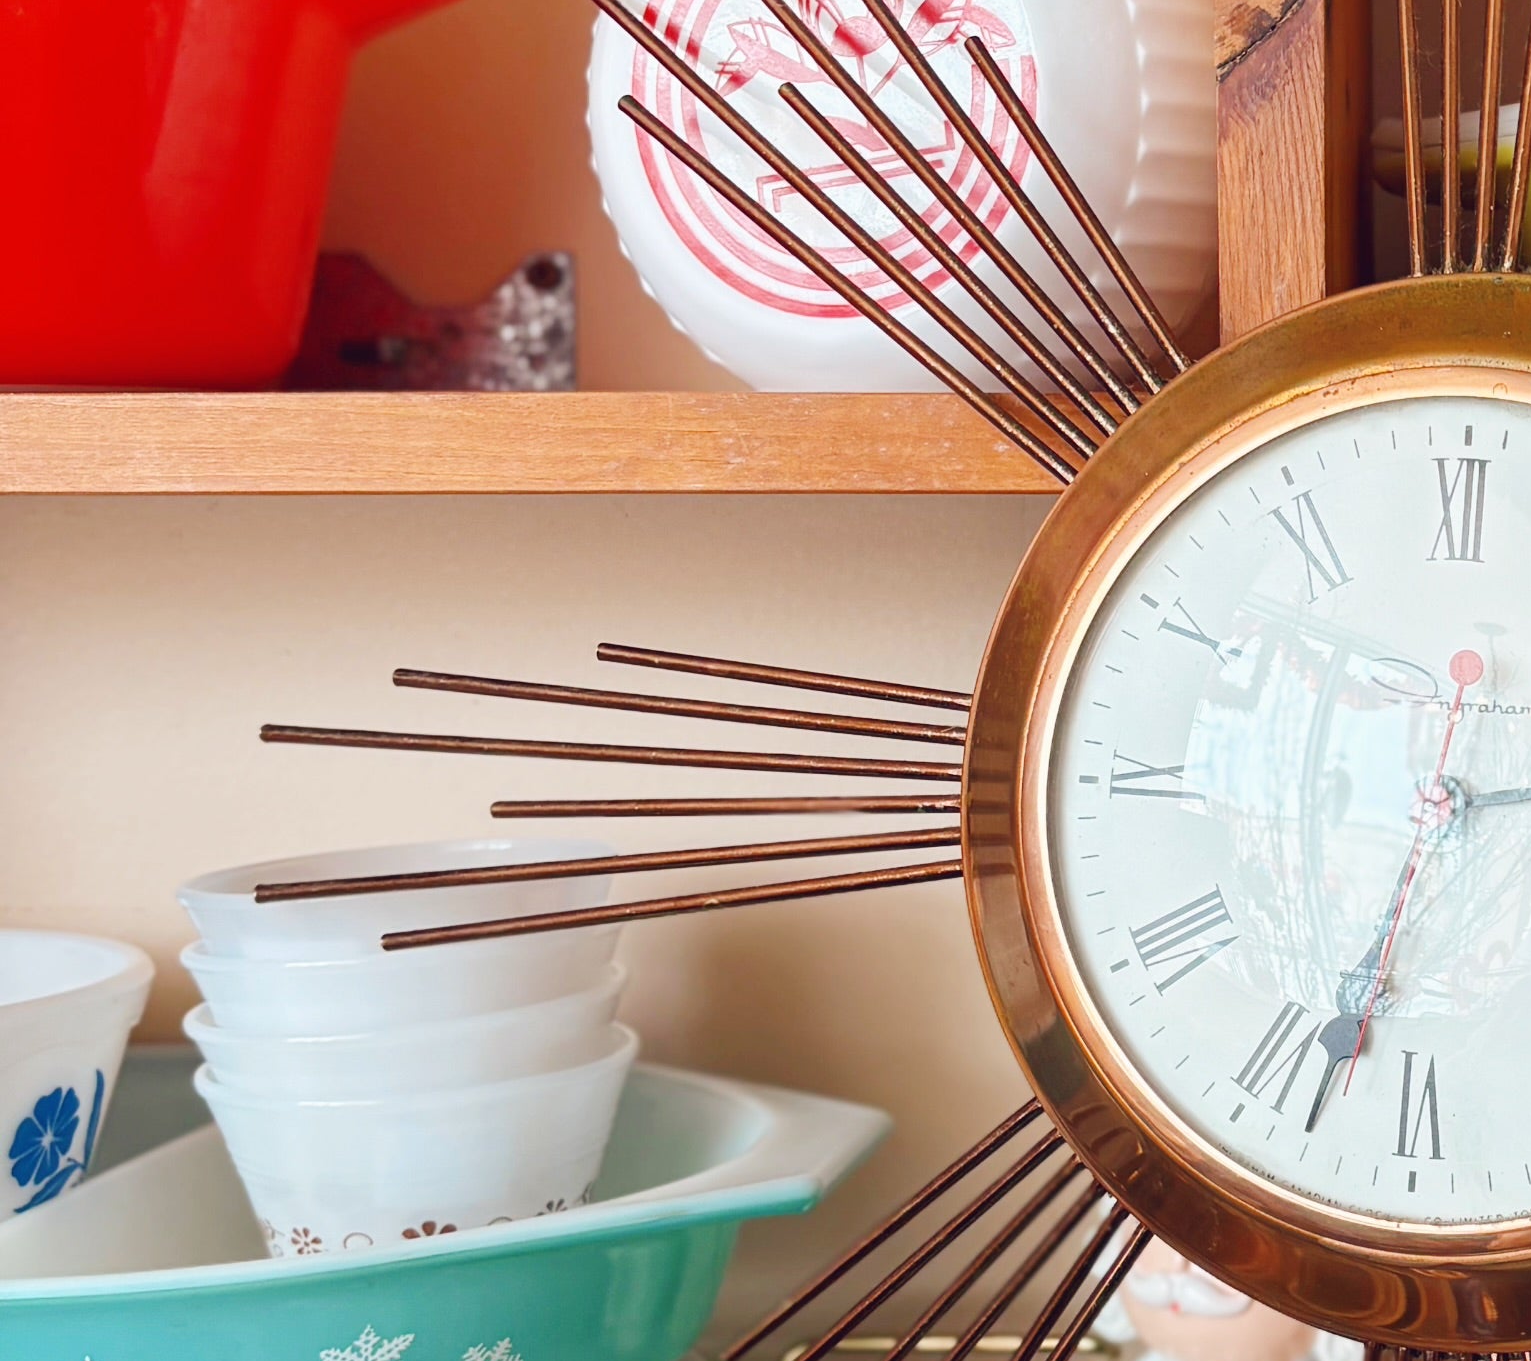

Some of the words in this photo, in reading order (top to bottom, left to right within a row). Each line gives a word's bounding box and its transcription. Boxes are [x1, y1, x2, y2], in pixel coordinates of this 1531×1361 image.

[1266, 489, 1355, 605] XI
[1425, 457, 1492, 564] XII
[1128, 882, 1241, 997] VIII
[1229, 1000, 1323, 1115] VII
[1391, 1049, 1446, 1160] VI
